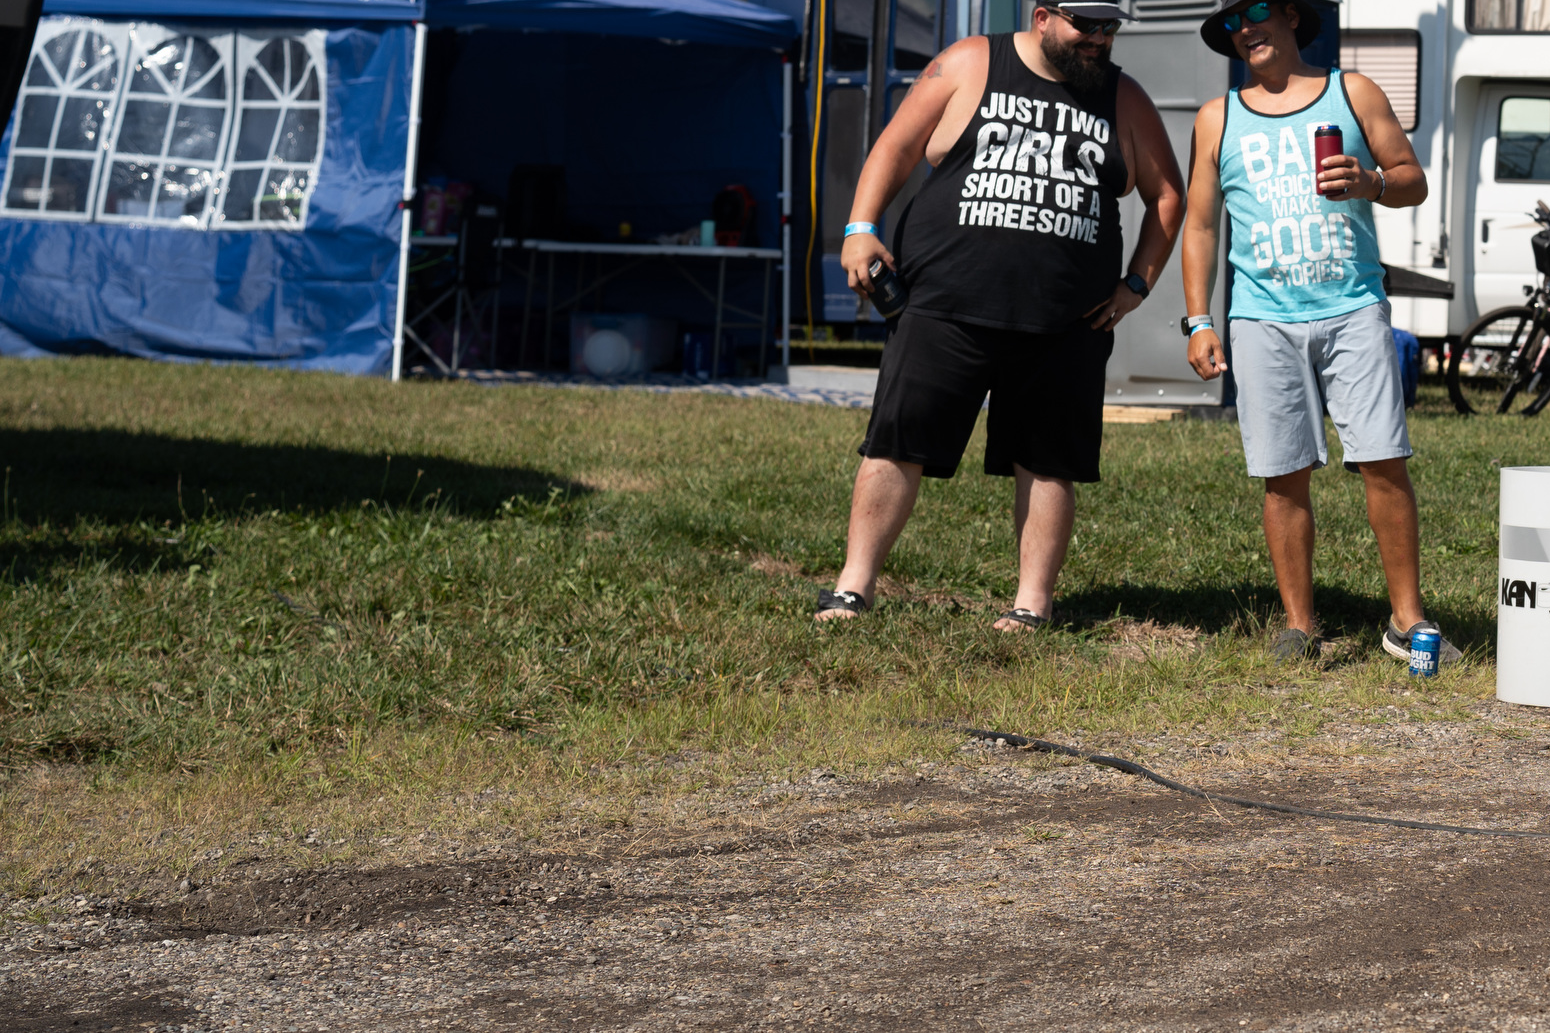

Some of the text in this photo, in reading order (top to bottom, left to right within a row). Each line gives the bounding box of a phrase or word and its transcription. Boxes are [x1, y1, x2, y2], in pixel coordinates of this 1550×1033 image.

[980, 92, 1110, 144] JUST TWO
[972, 122, 1105, 186] GIRLS
[961, 172, 1100, 217] SHORT OF A
[1255, 171, 1317, 203] CHOIC
[958, 201, 1100, 244] THREESOME
[1271, 194, 1321, 219] MAKE
[1251, 212, 1357, 269] GOOD
[1268, 259, 1345, 287] STORIES
[1501, 577, 1537, 609] KAN
[1410, 648, 1432, 661] BUD
